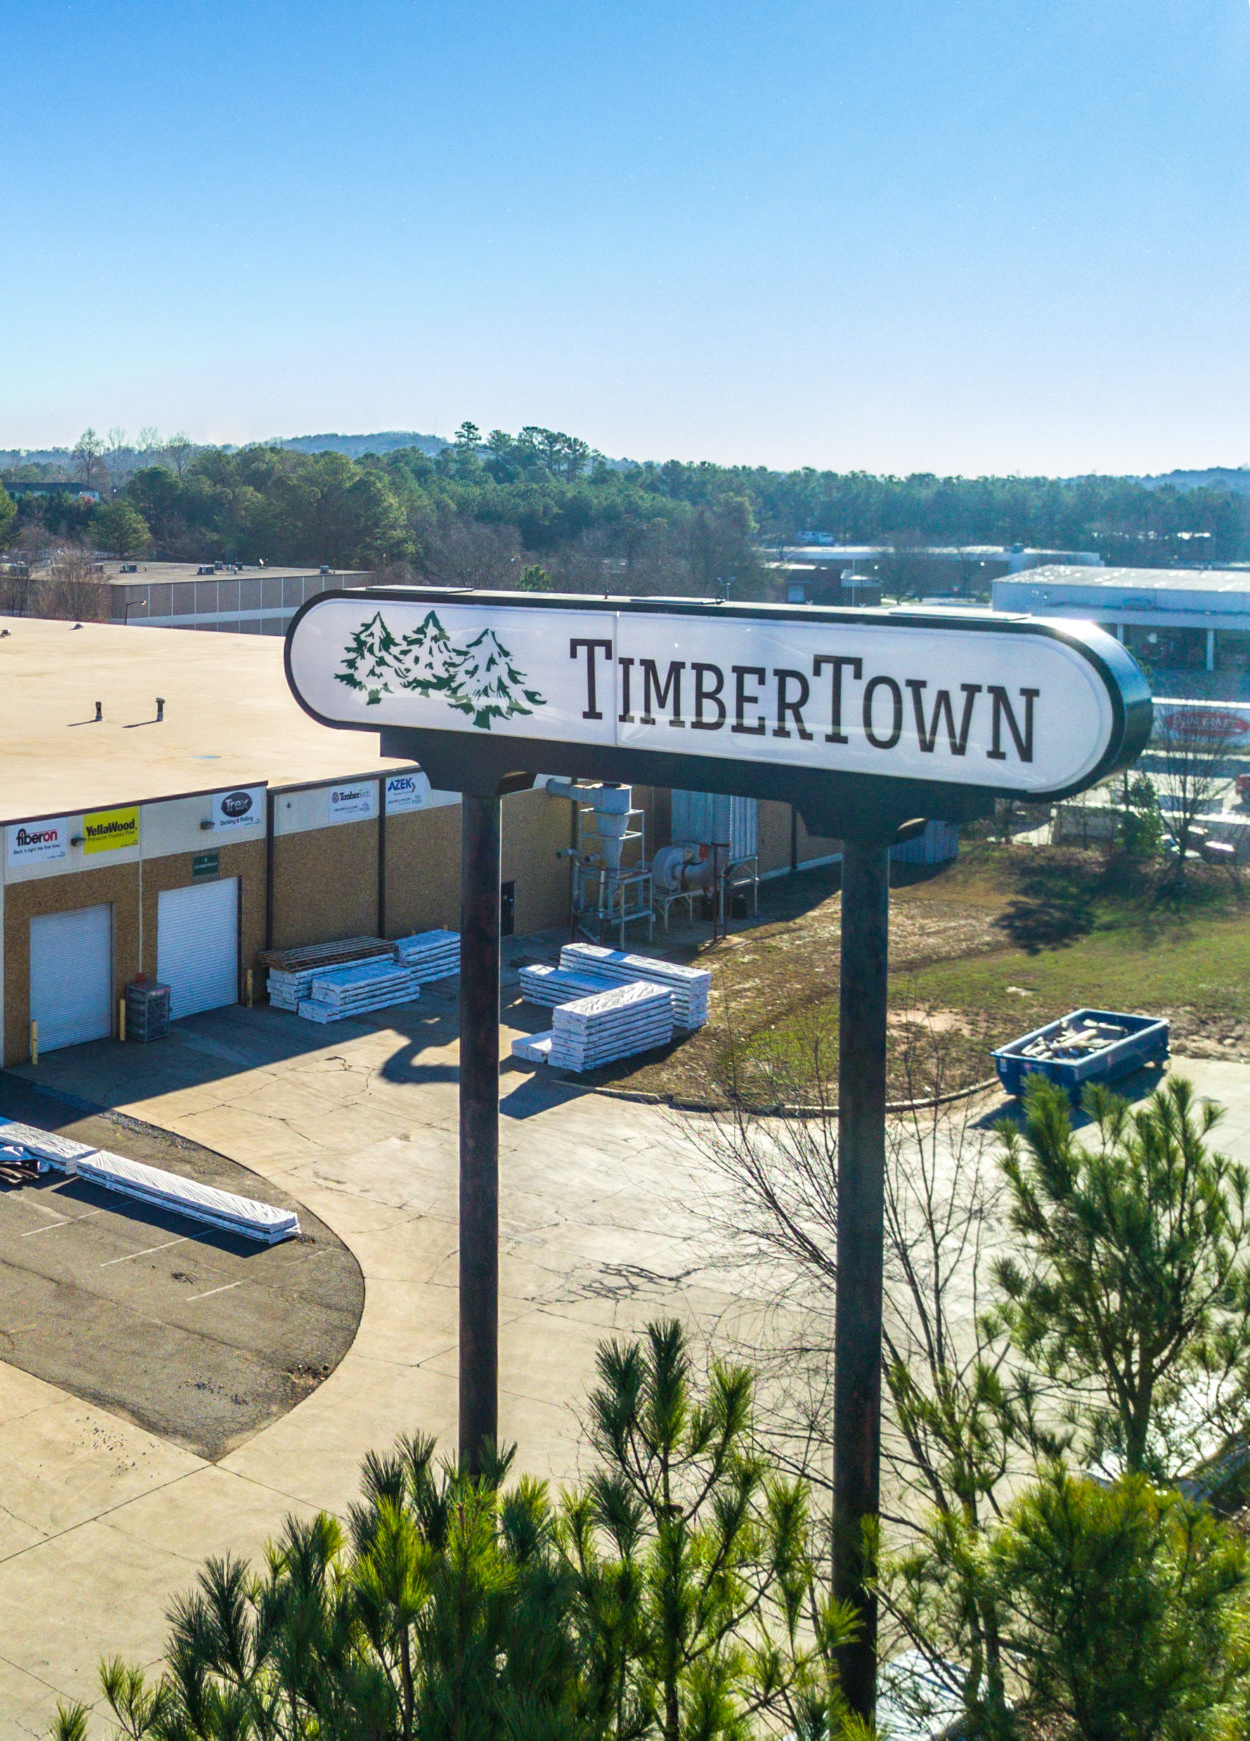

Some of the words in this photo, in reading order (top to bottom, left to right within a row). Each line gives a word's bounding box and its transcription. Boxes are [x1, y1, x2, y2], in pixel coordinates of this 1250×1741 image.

[388, 777, 412, 792] AZEK
[339, 788, 371, 801] TimberTech
[225, 798, 250, 812] Trex
[86, 818, 135, 837] YellaWood
[16, 828, 58, 847] fiberon
